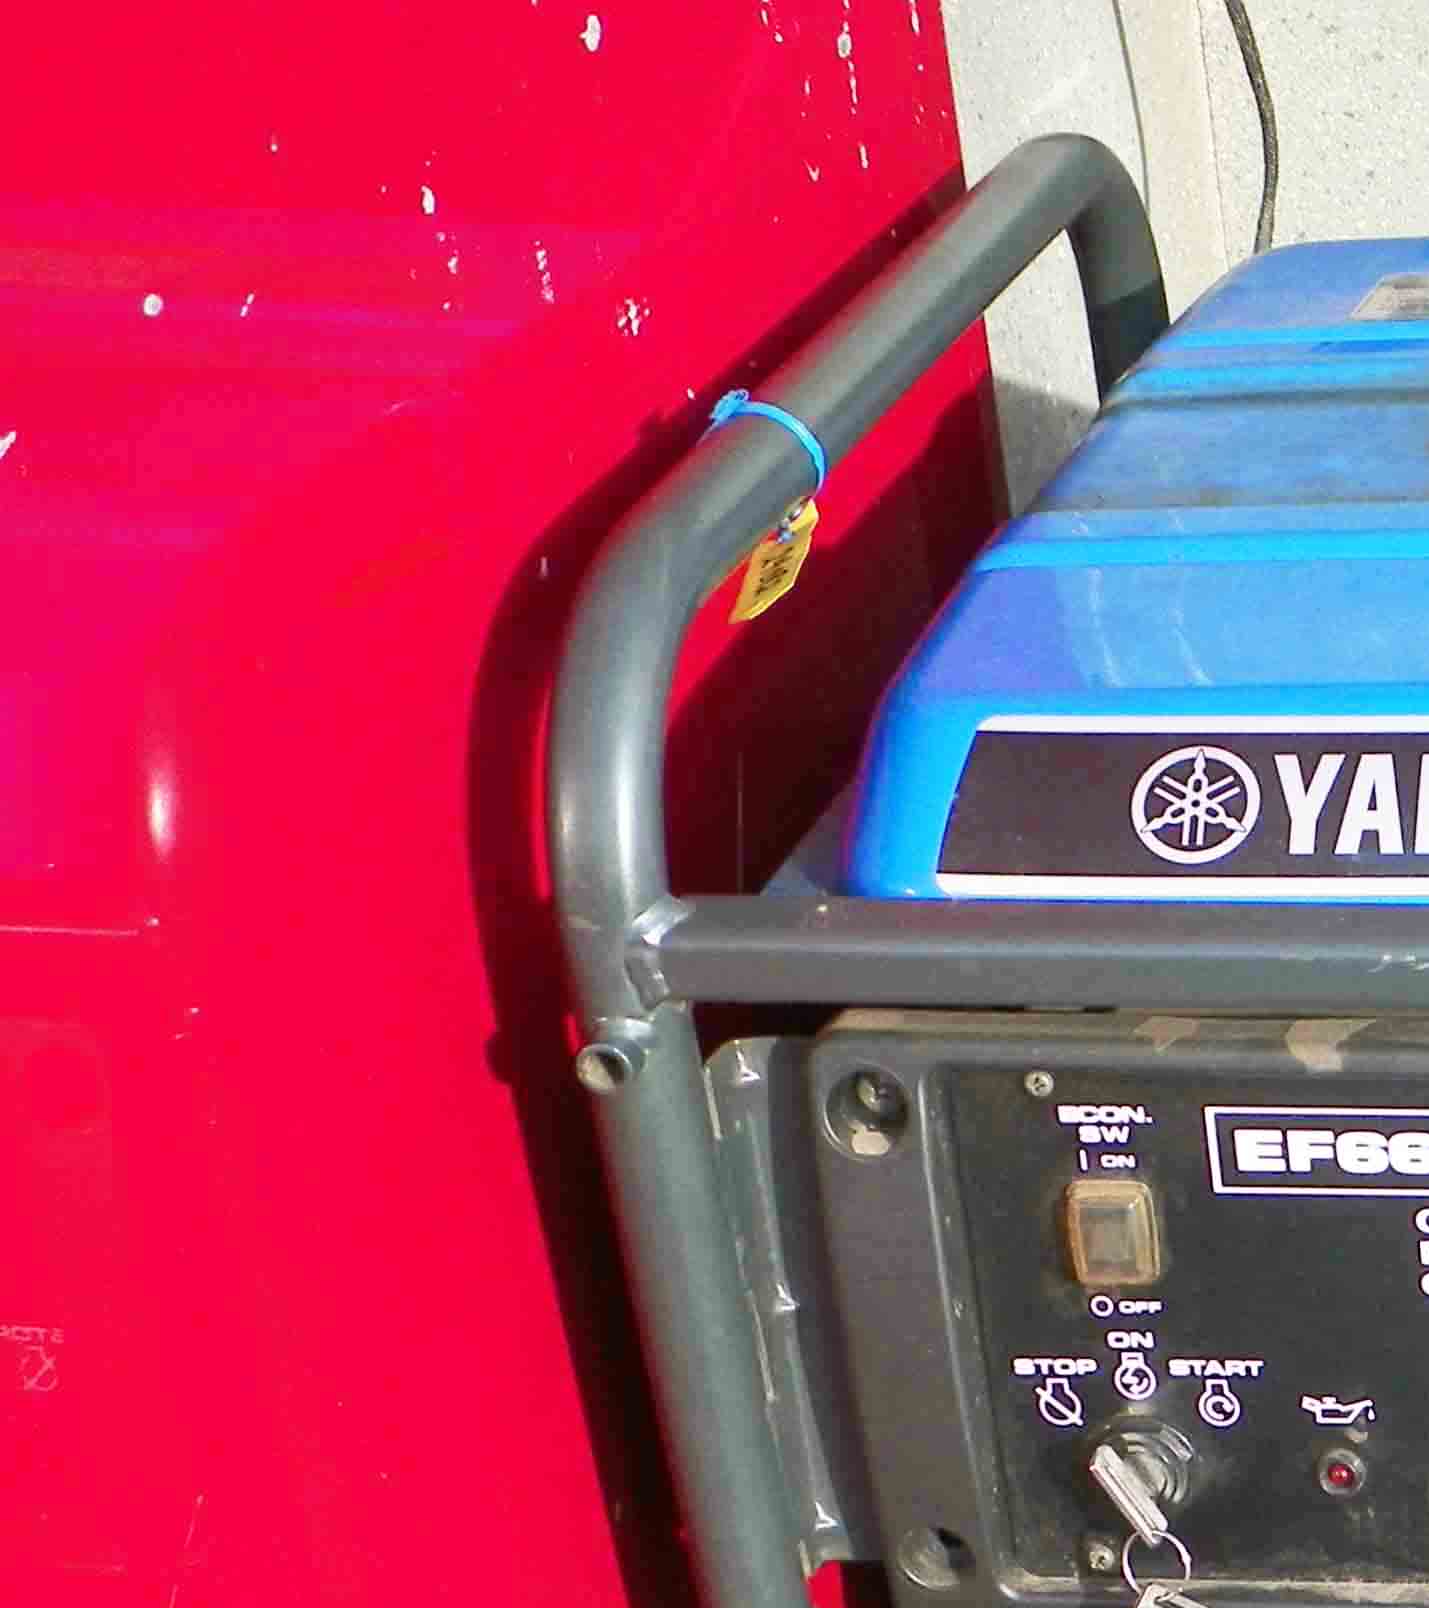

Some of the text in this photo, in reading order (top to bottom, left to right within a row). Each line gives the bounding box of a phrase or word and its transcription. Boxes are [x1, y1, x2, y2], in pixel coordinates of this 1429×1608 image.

[1057, 1105, 1153, 1124] ECON.
[1078, 1125, 1130, 1143] SW
[1101, 1154, 1136, 1168] ON
[1118, 1300, 1162, 1314] OFF
[1107, 1331, 1154, 1349] ON
[1013, 1358, 1097, 1377] STOP
[1168, 1359, 1264, 1377] START
